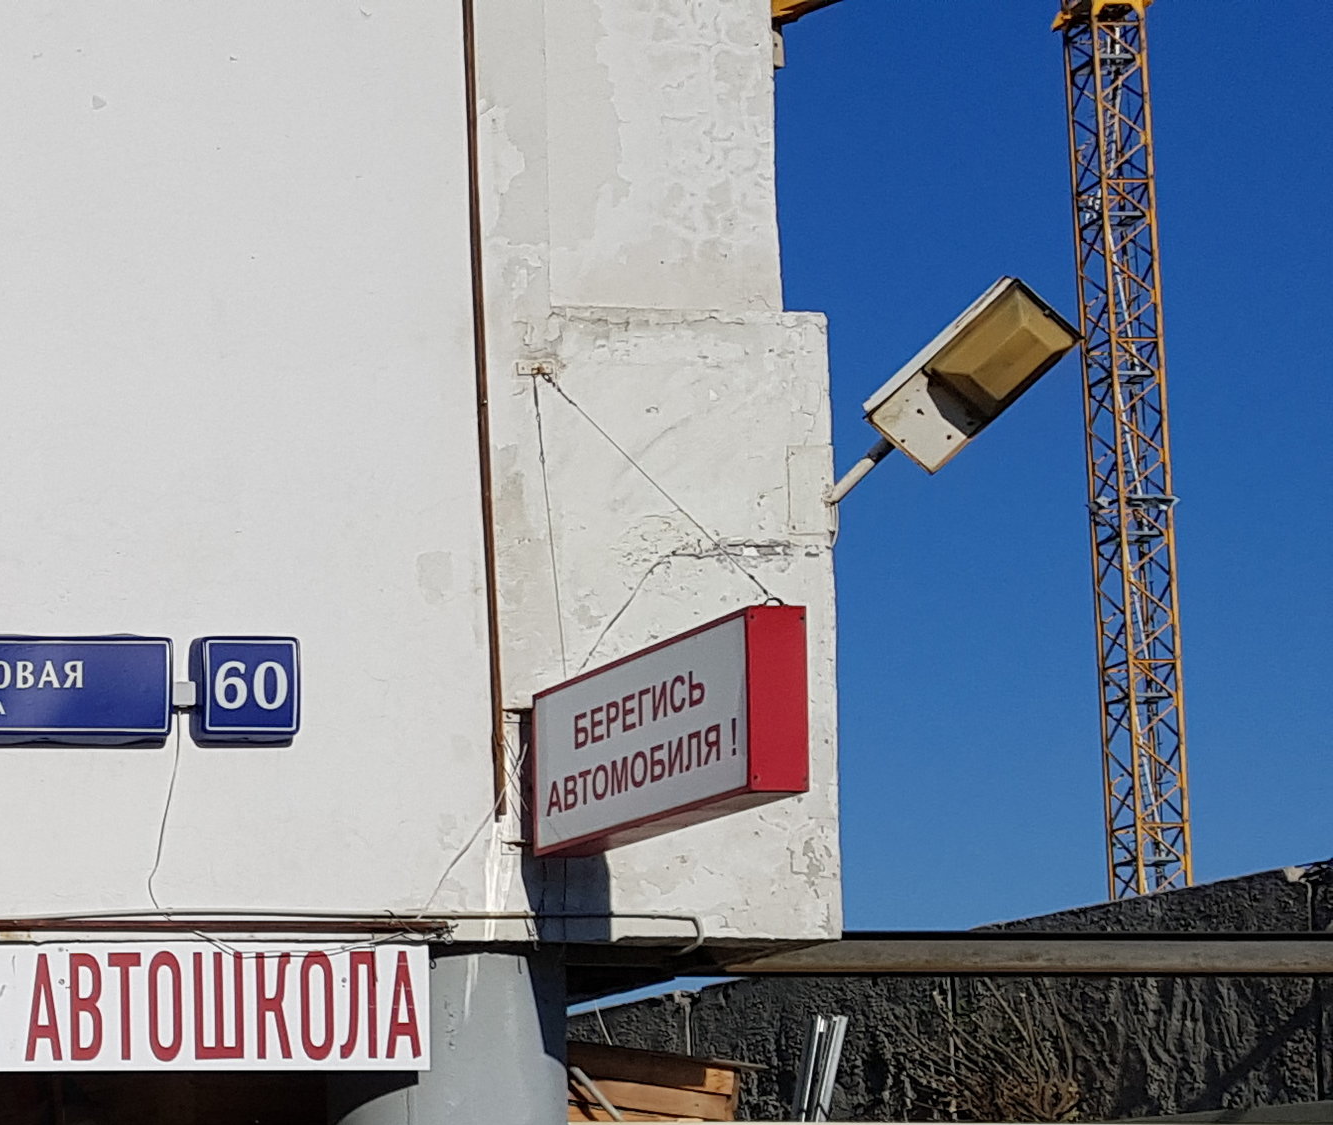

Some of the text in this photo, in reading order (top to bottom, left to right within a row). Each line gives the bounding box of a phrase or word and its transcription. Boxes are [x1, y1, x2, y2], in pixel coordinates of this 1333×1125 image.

[213, 660, 290, 711] 60
[574, 670, 706, 750] БЕРЕГИСЬ
[25, 950, 421, 1062] АВТОШКОЛА
